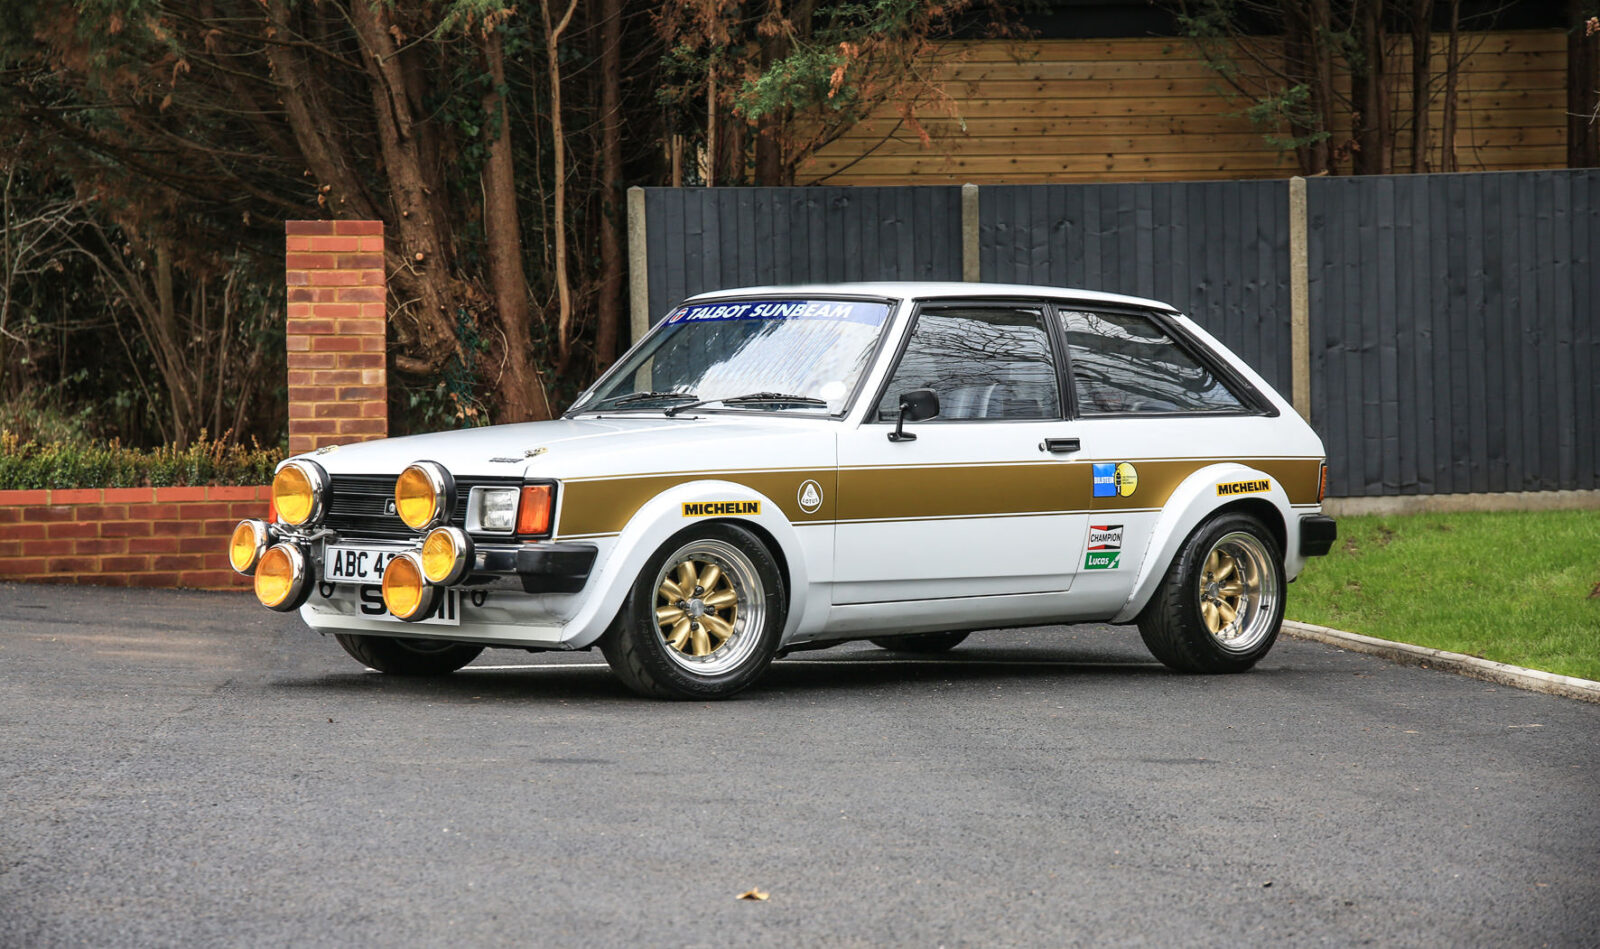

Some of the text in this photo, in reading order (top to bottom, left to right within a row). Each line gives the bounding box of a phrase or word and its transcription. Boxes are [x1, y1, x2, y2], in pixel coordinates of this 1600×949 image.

[686, 303, 852, 320] TALBOT SUNBEAM
[1218, 480, 1269, 495] MICHELIN
[684, 502, 758, 515] MICHELIN
[1090, 533, 1121, 542] CHAMPION
[333, 550, 396, 579] ABC 4
[1088, 555, 1110, 566] Lucas
